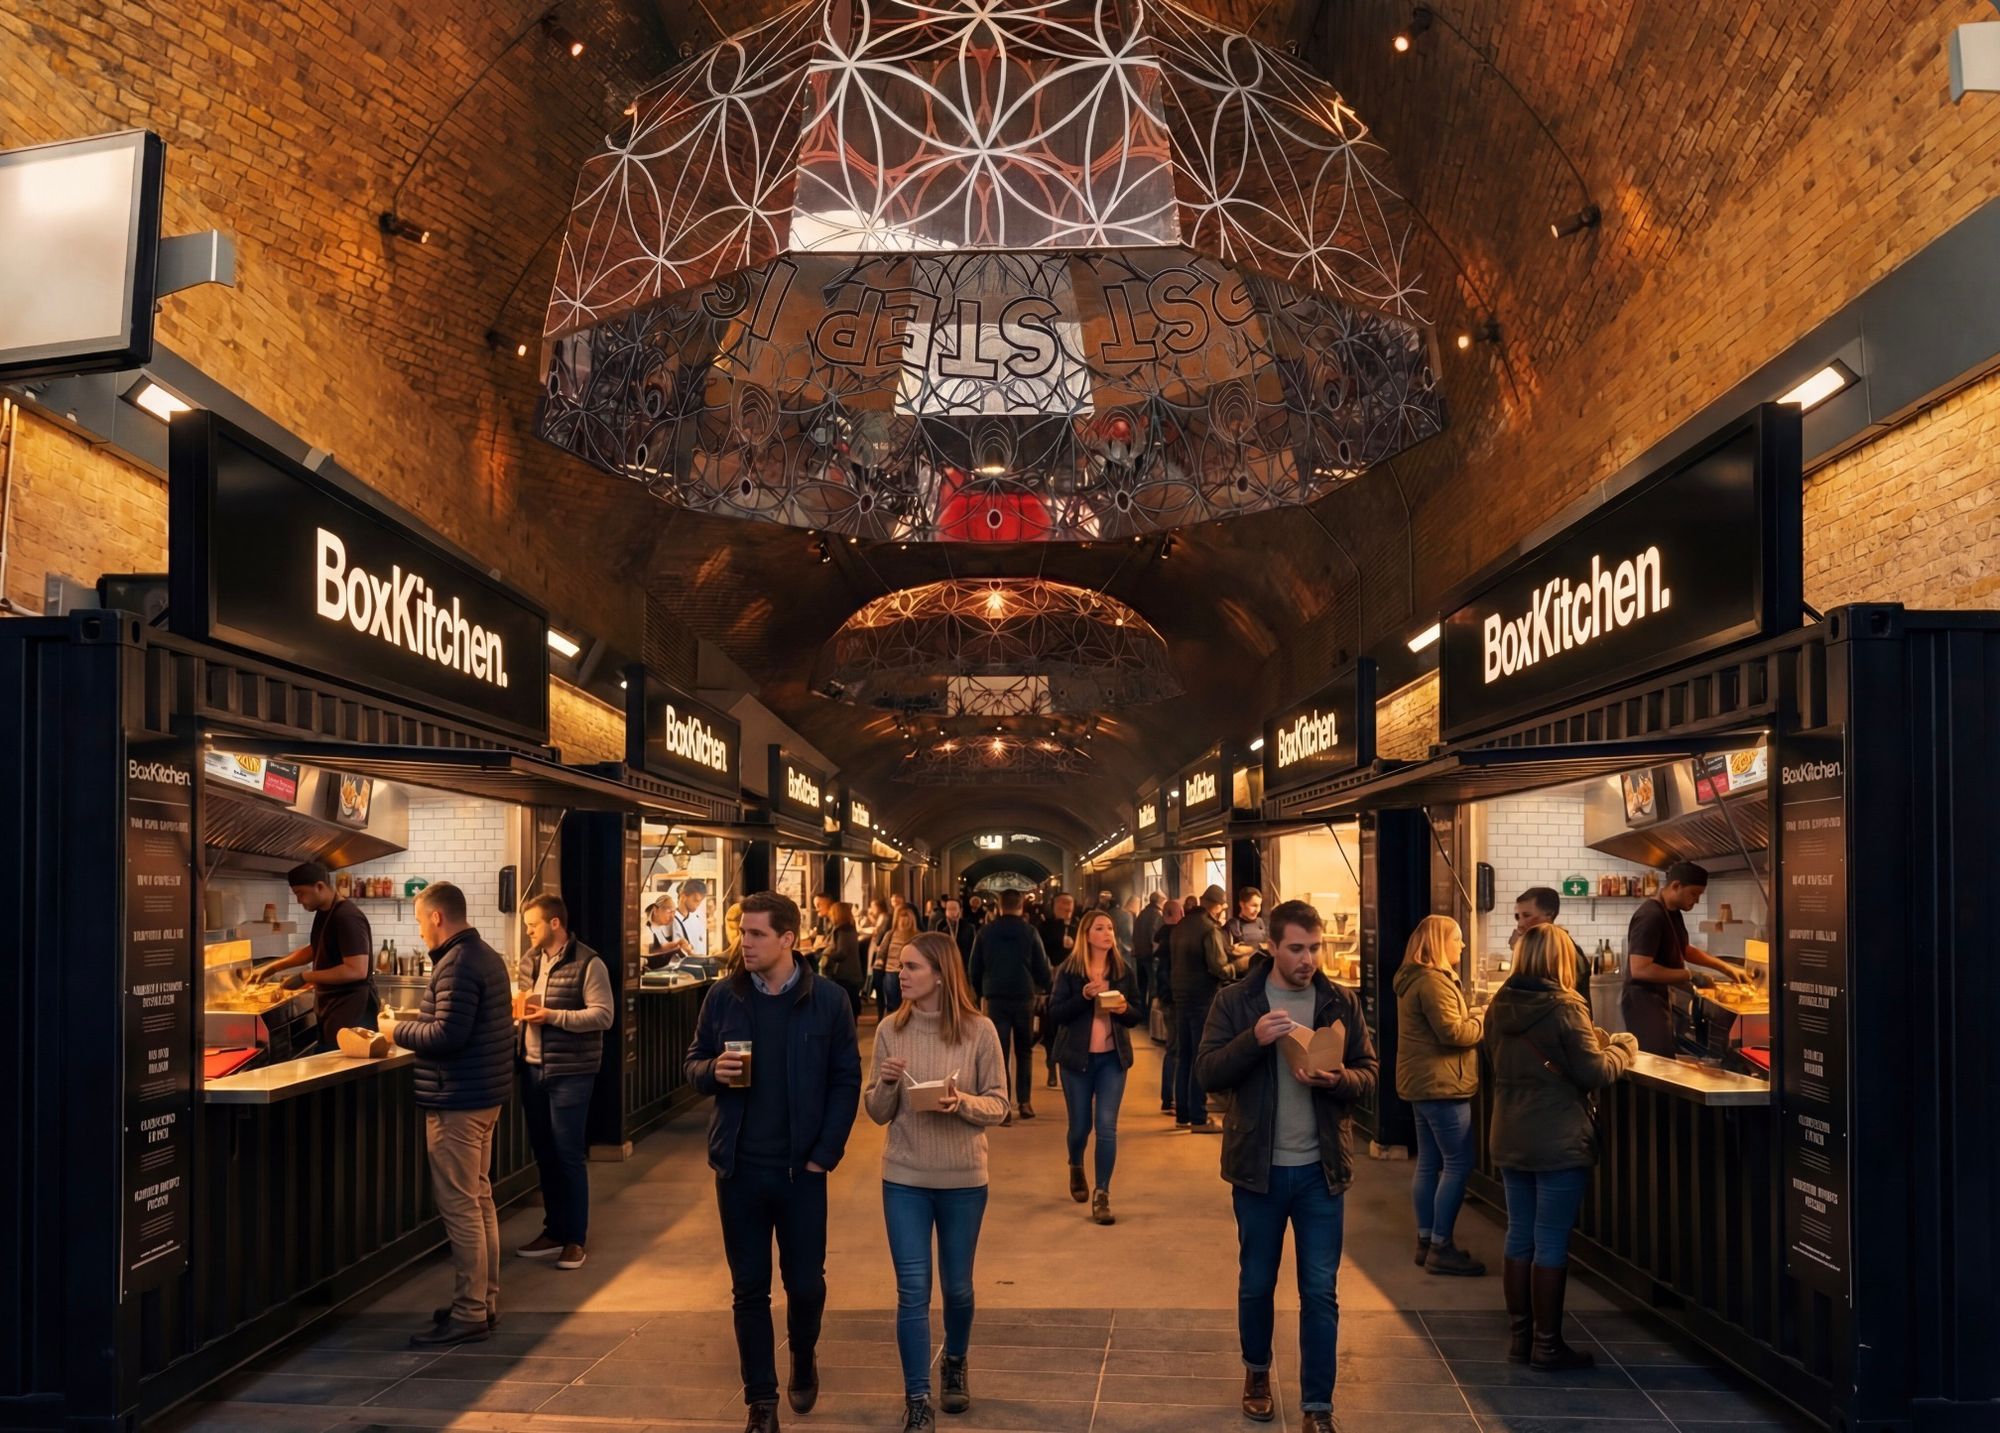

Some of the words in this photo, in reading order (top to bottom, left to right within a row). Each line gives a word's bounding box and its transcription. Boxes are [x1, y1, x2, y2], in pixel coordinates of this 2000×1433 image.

[815, 284, 1063, 381] STEP
[316, 528, 508, 688] BoxKitchen.
[1484, 546, 1670, 684] BoxKitchen.
